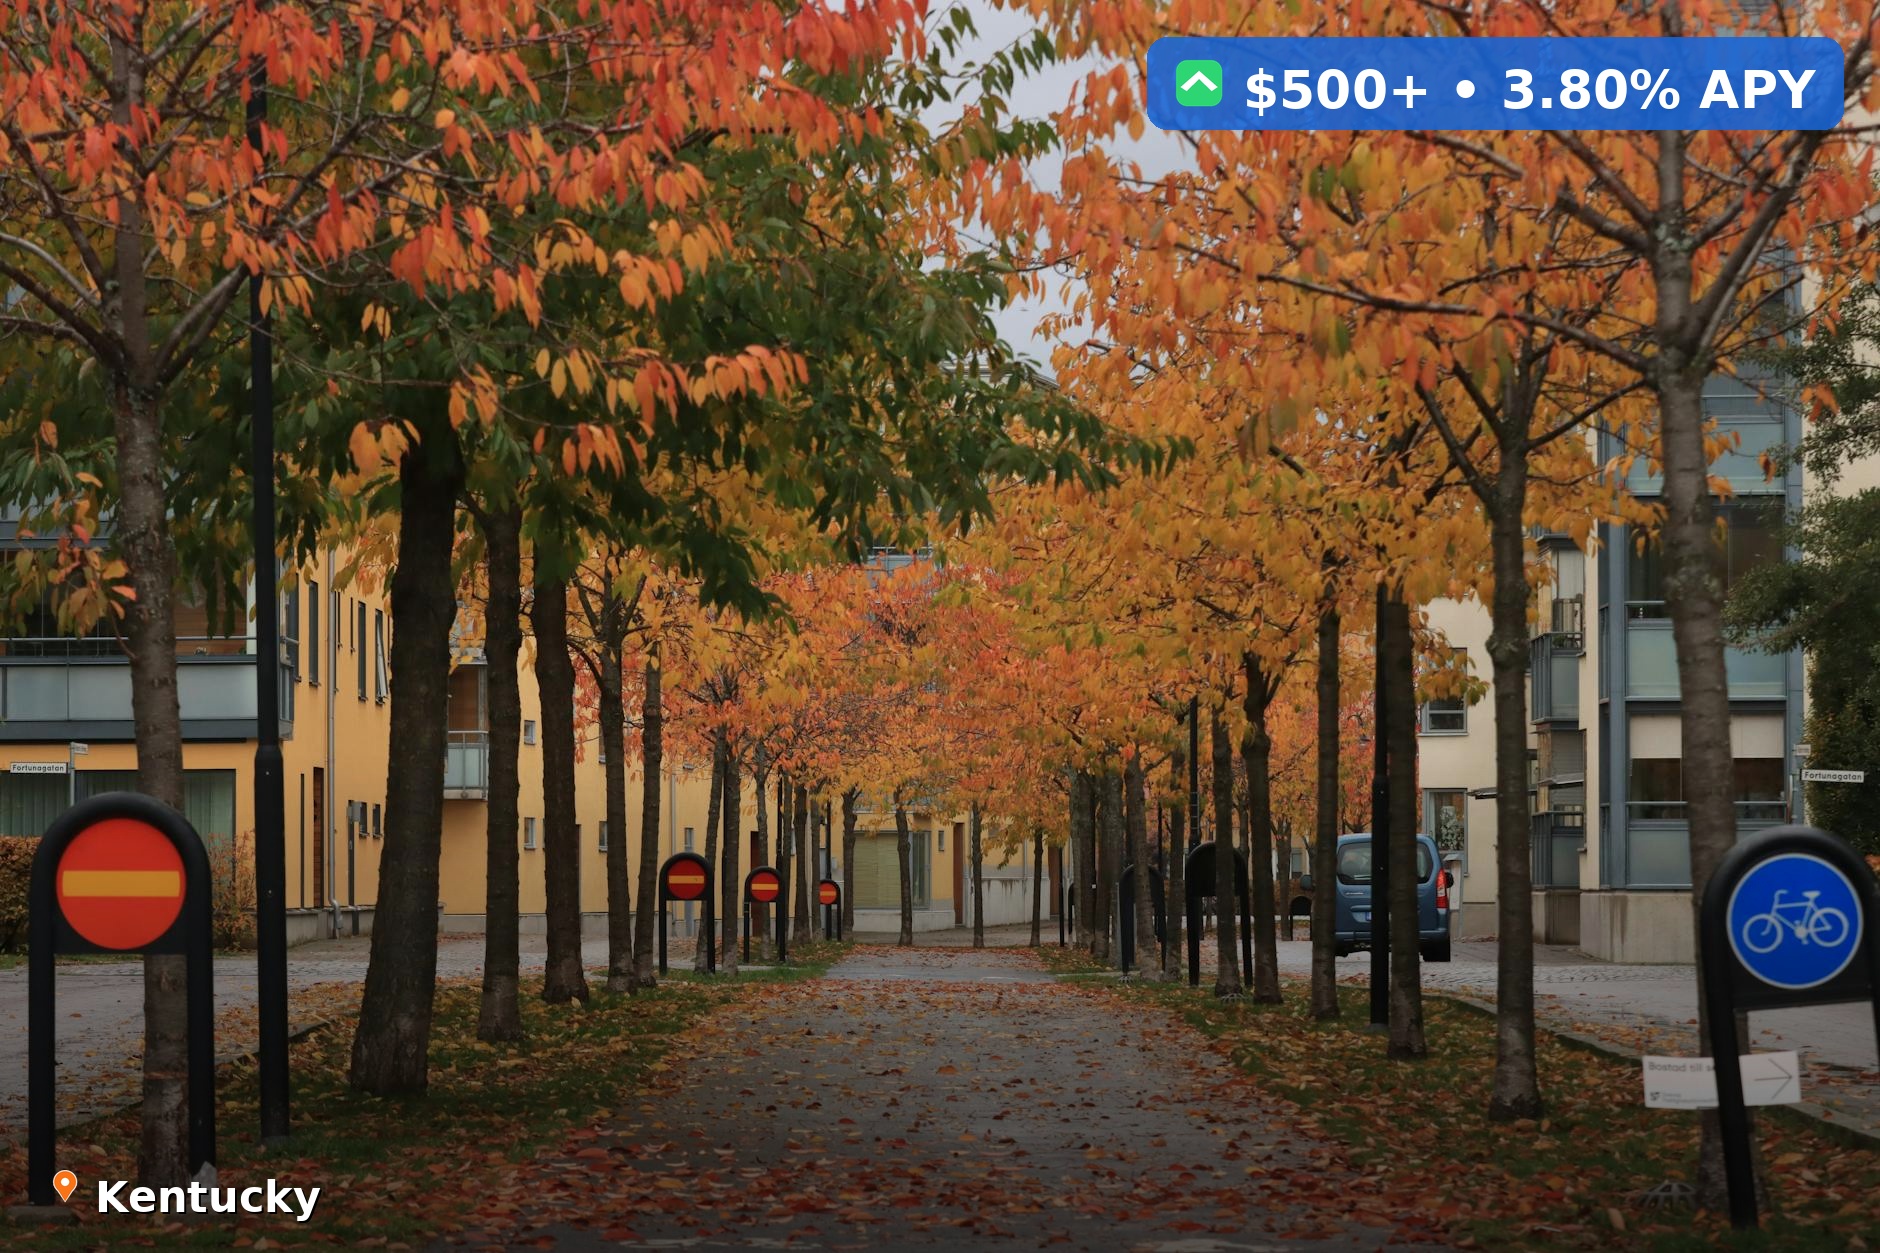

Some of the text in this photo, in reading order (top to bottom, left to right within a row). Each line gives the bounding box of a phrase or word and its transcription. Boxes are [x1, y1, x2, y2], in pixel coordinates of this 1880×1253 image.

[12, 764, 64, 773] Fortunagatan
[1804, 771, 1862, 781] Fortunagatan
[1648, 1061, 1686, 1072] Bostad
